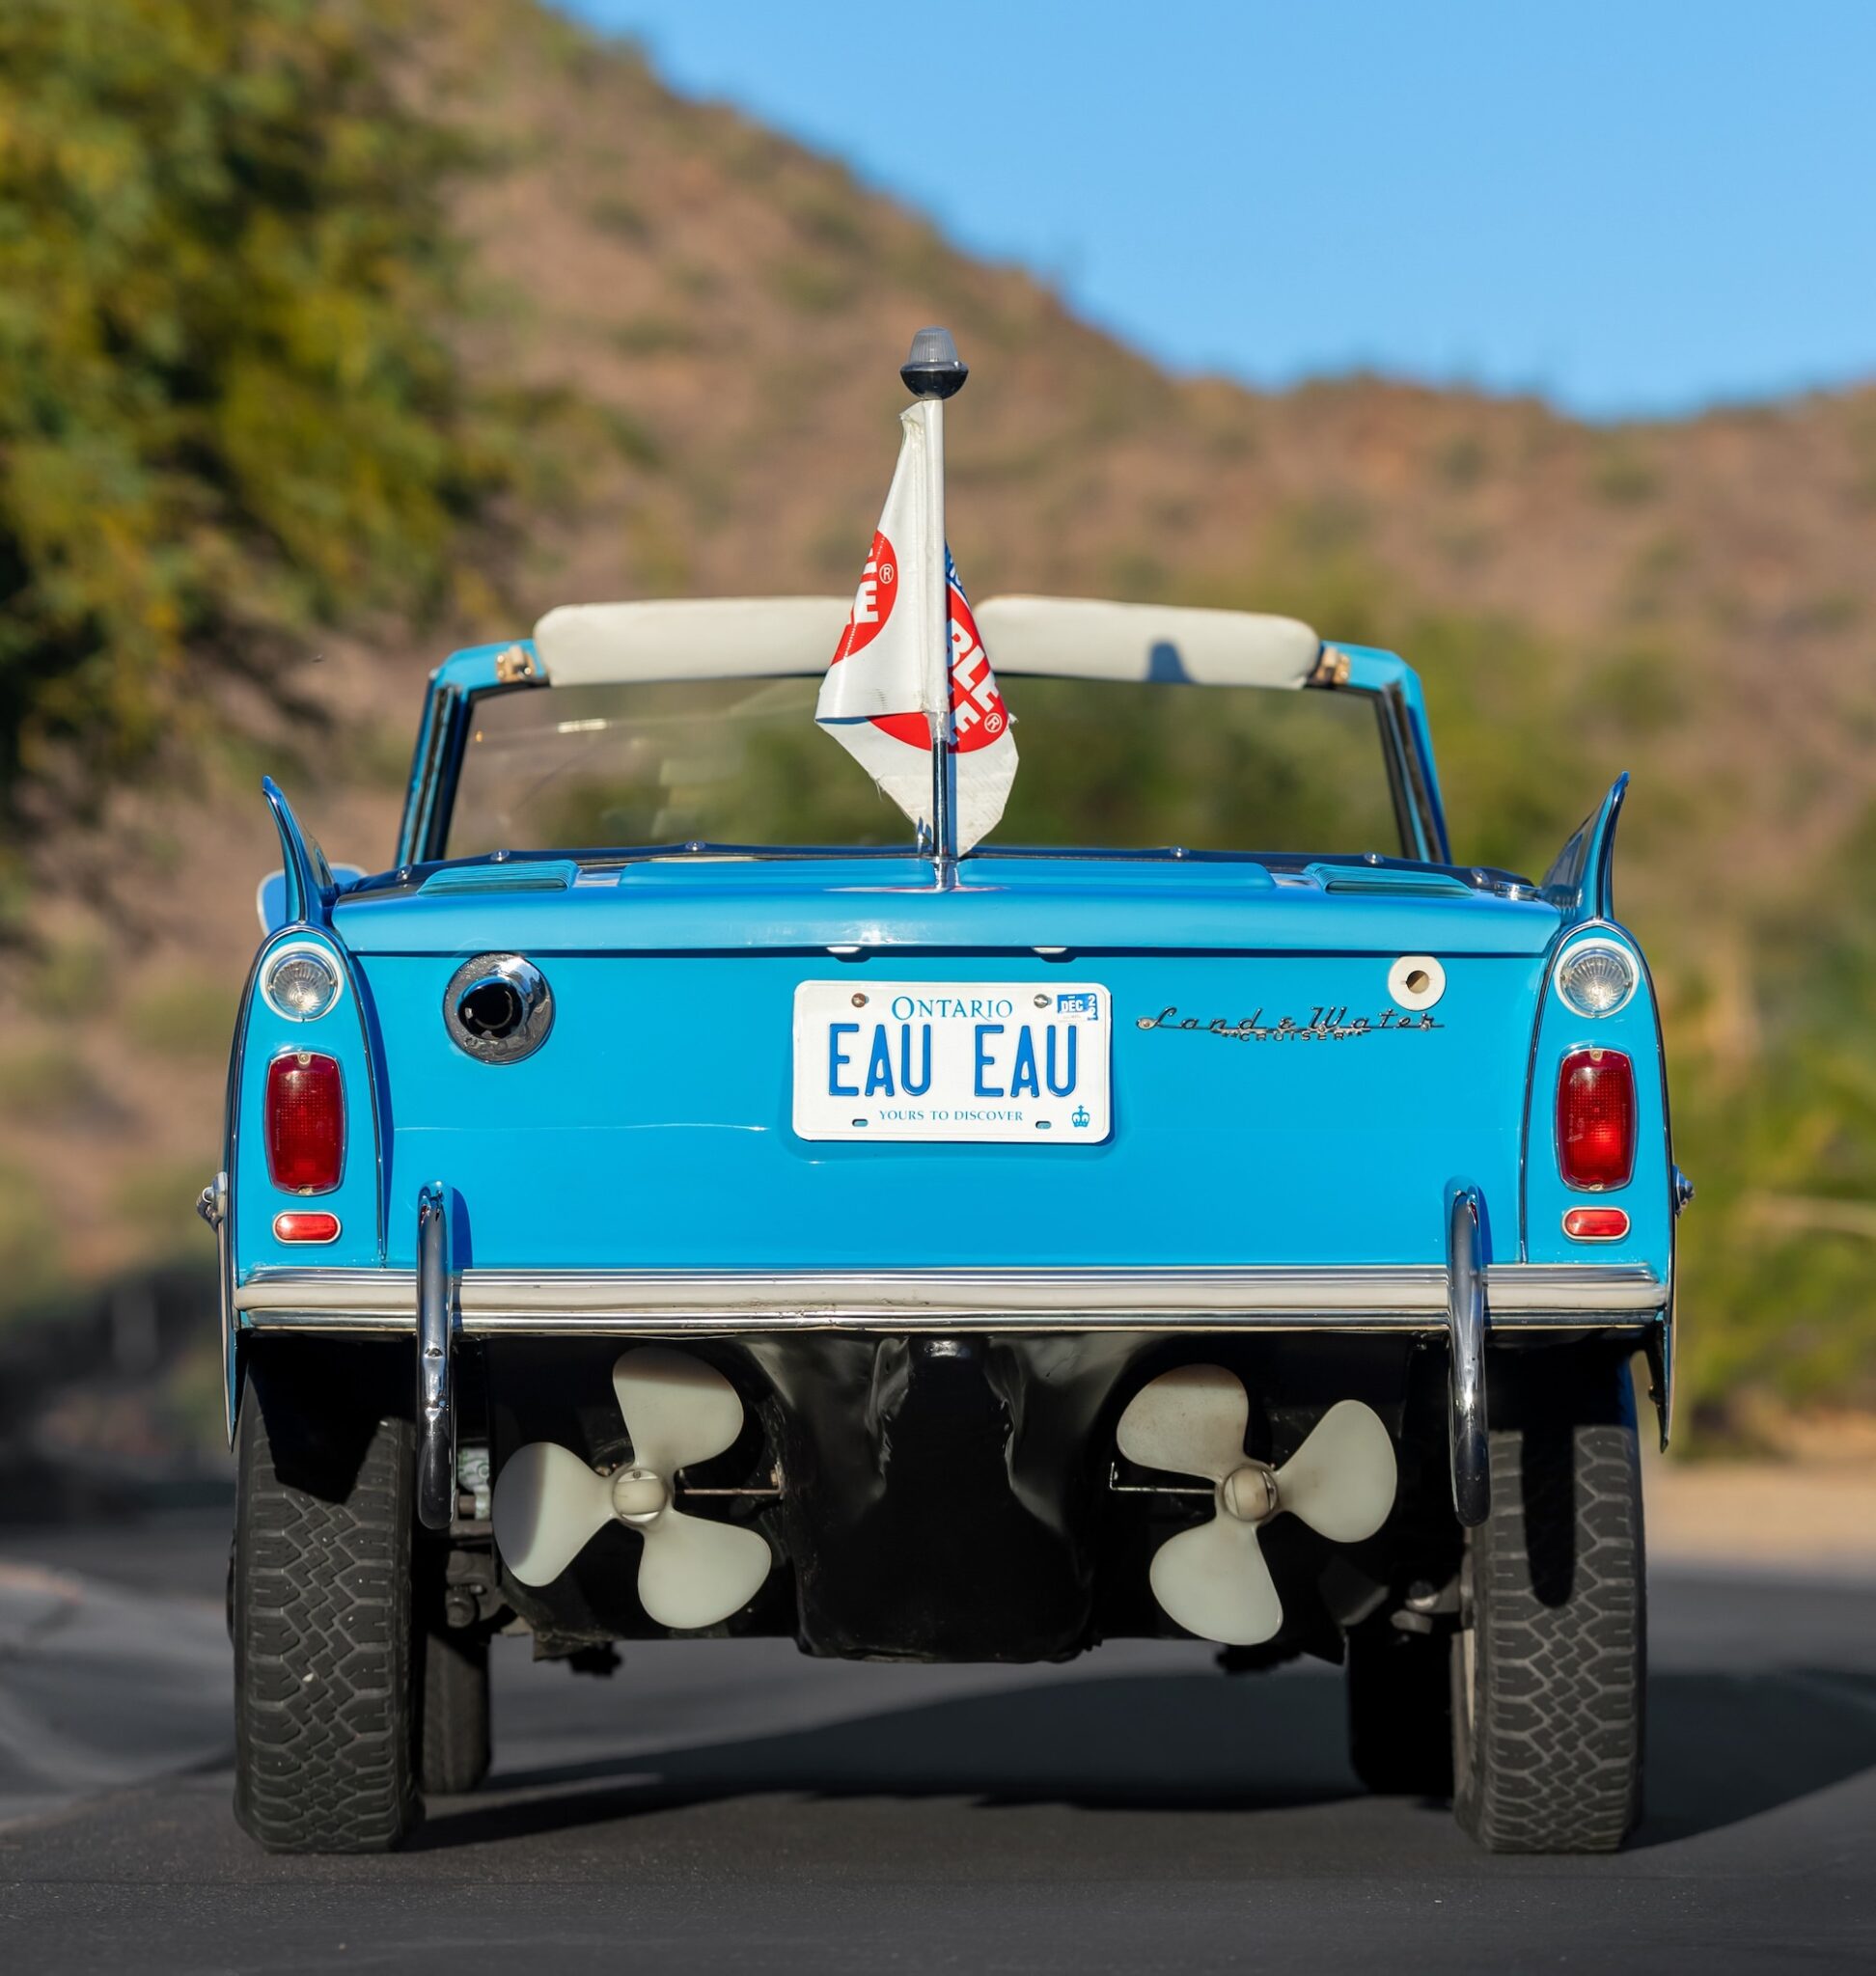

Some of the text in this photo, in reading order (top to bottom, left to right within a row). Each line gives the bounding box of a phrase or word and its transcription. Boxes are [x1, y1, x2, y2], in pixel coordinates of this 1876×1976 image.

[891, 996, 1014, 1022] ONTARIO
[1060, 1000, 1084, 1012] DEC
[1136, 1006, 1438, 1031] Land & Water
[1239, 1031, 1345, 1042] CRUISER
[828, 1023, 1078, 1099] EAU EAU
[879, 1110, 1024, 1122] YOURS TO DISCOVER
